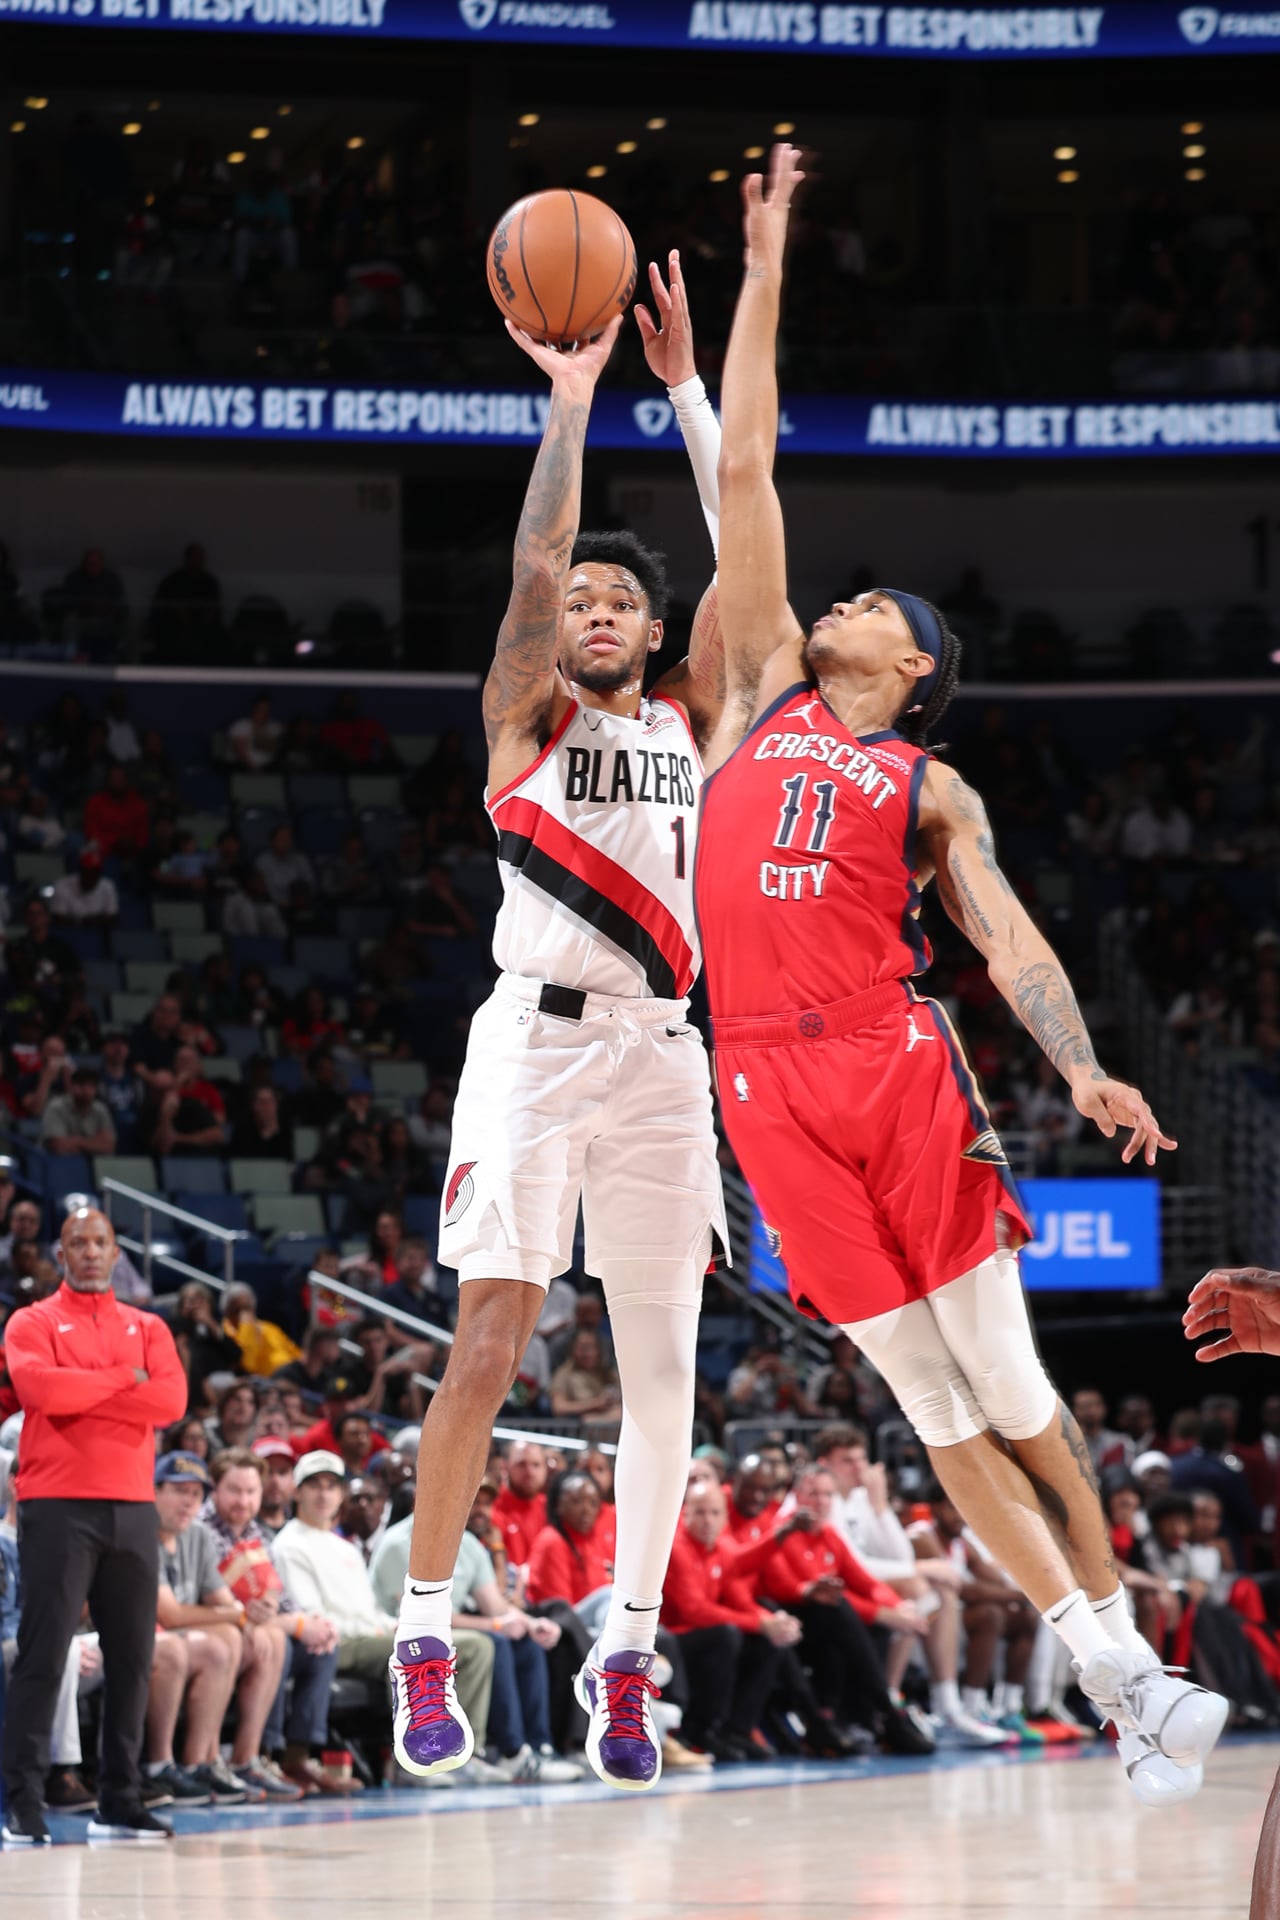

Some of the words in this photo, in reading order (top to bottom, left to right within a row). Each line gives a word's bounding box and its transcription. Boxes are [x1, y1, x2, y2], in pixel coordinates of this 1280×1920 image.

[500, 2, 614, 29] FANDUEL
[690, 2, 815, 43] ALWAYS
[821, 6, 882, 45] BET
[887, 9, 1101, 49] RESPONSIBLY
[0, 385, 49, 410] UEL
[122, 384, 255, 428] ALWAYS
[262, 389, 327, 429] BET
[333, 392, 549, 434] RESPONSIBLY
[867, 404, 999, 447] ALWAYS
[1005, 407, 1069, 447] BET
[1075, 403, 1280, 446] RESPONSIBL
[565, 747, 695, 808] BLAZERS
[753, 732, 898, 810] CRESCENT
[772, 772, 838, 852] 11
[670, 815, 686, 879] 1
[759, 861, 831, 900] CITY
